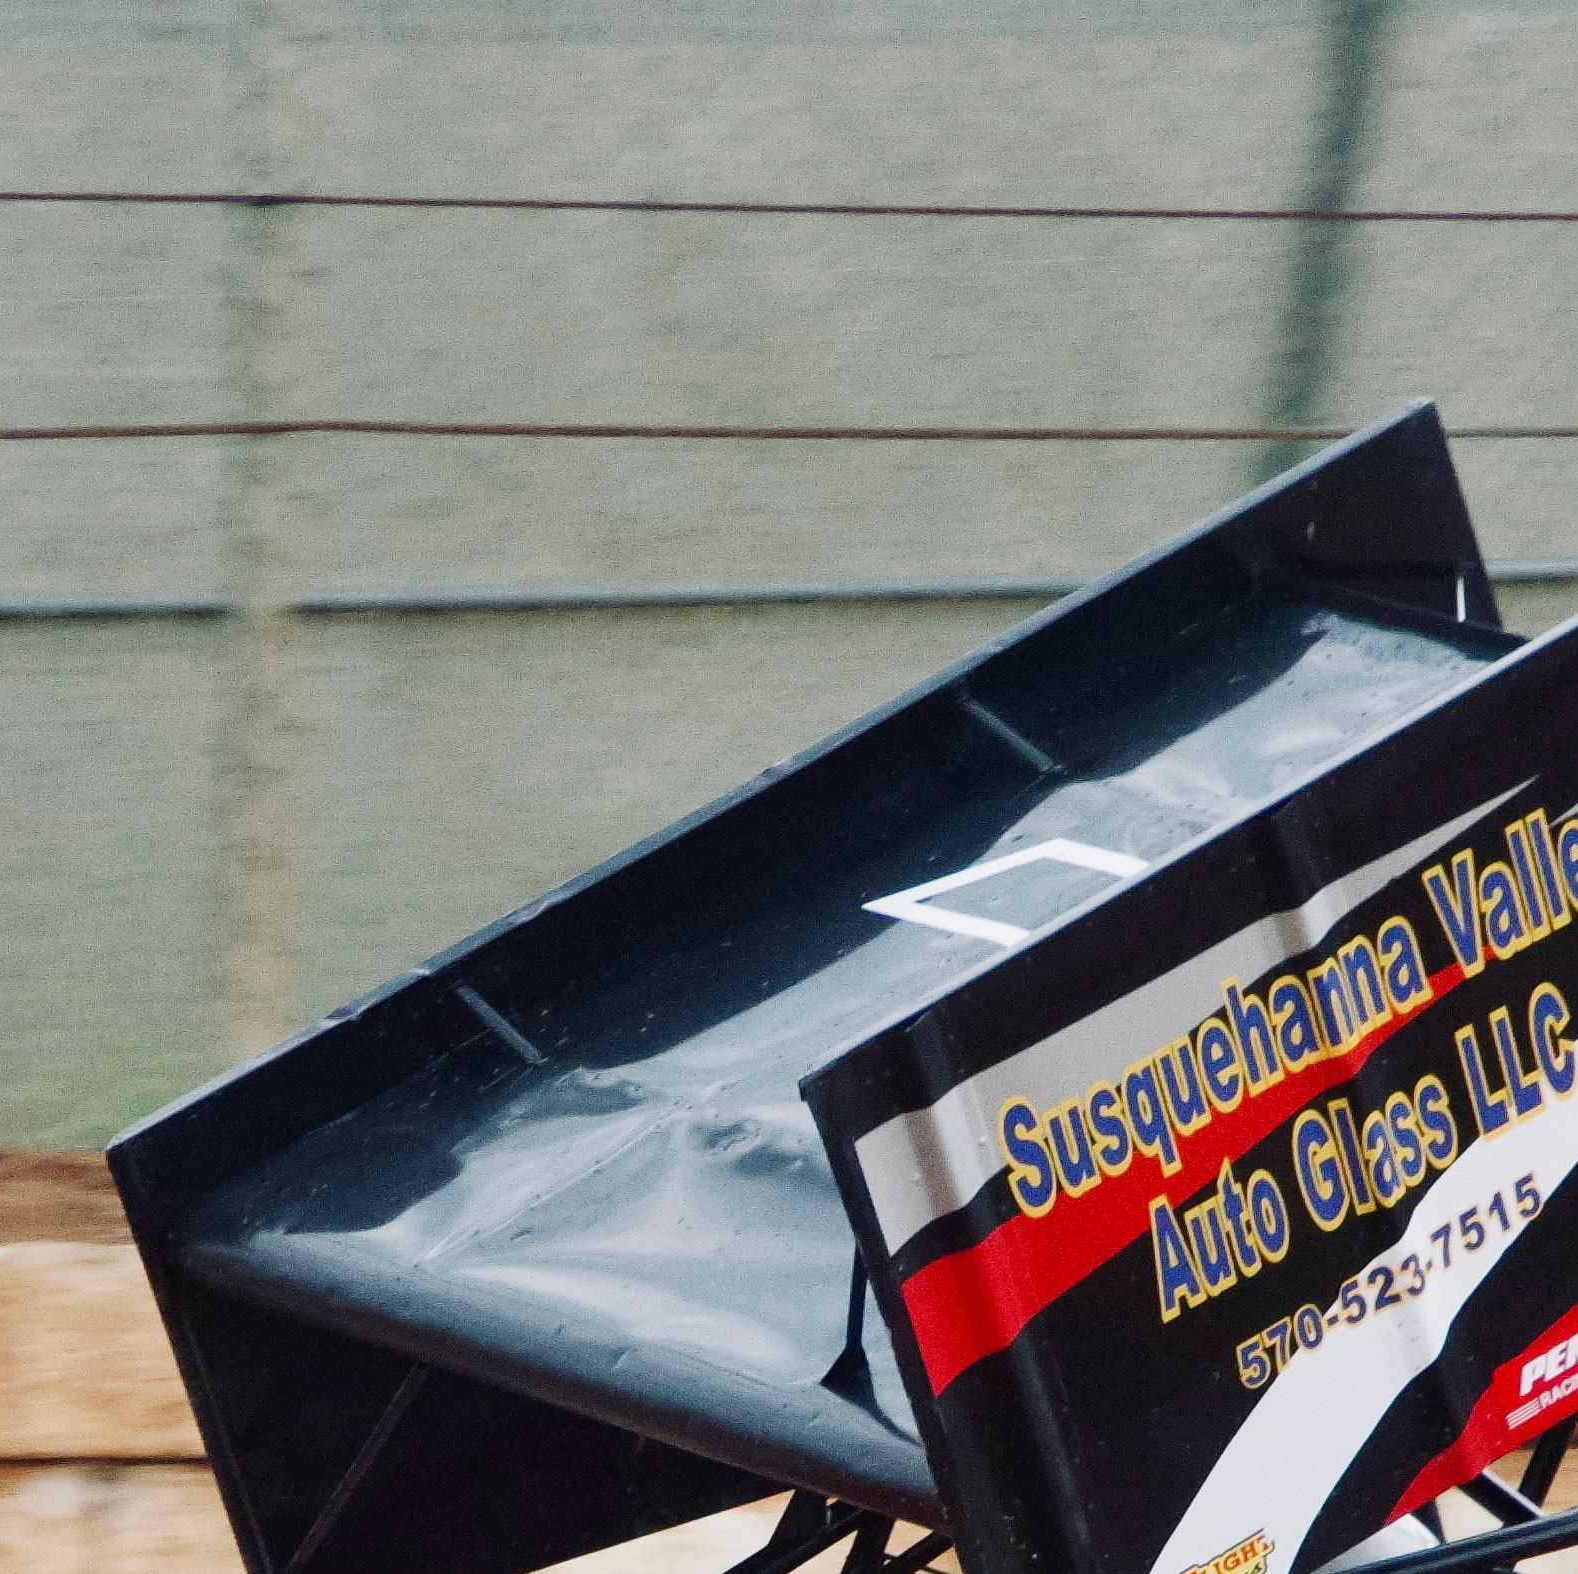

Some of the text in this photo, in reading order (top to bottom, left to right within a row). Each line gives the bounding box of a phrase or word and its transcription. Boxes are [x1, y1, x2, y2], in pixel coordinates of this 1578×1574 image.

[998, 916, 1433, 1217] Susquehanna
[1148, 982, 1577, 1322] Auto Glass LLC
[1235, 1171, 1544, 1390] 570-523-7515
